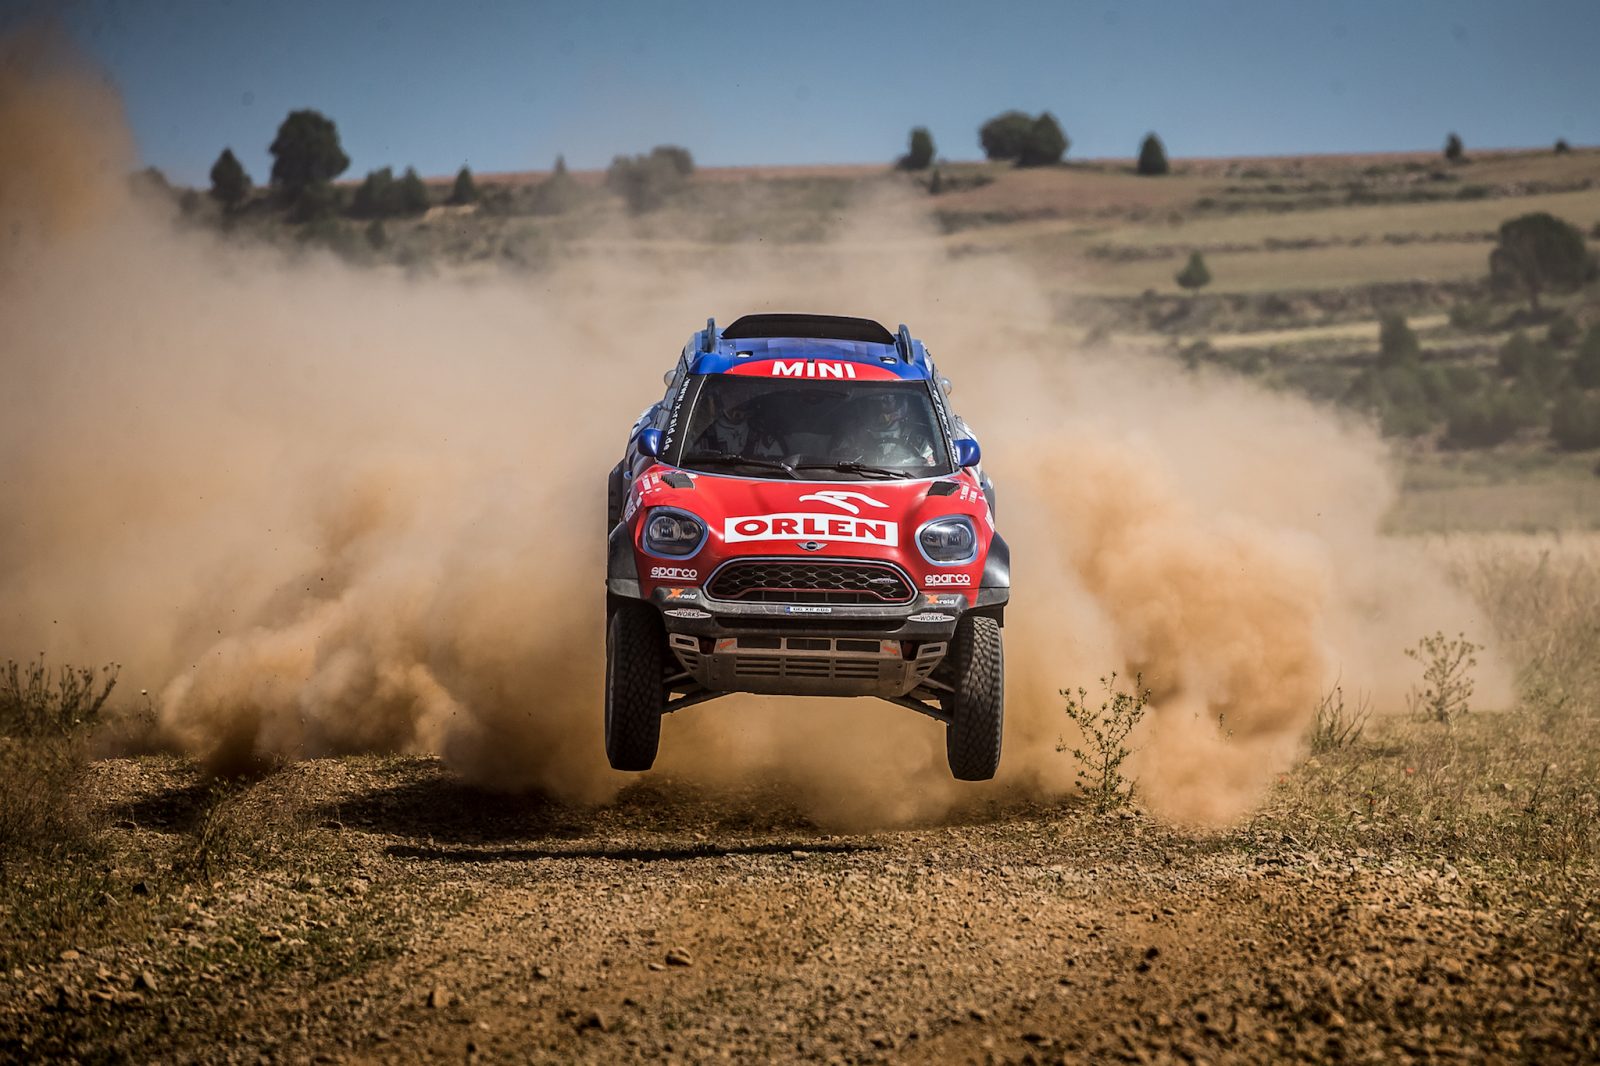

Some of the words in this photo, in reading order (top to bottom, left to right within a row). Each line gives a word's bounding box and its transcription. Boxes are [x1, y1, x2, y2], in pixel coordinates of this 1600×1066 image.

[772, 361, 856, 378] MINI
[734, 518, 886, 540] ORLEN
[651, 566, 698, 579] sparco
[925, 574, 971, 585] sparco
